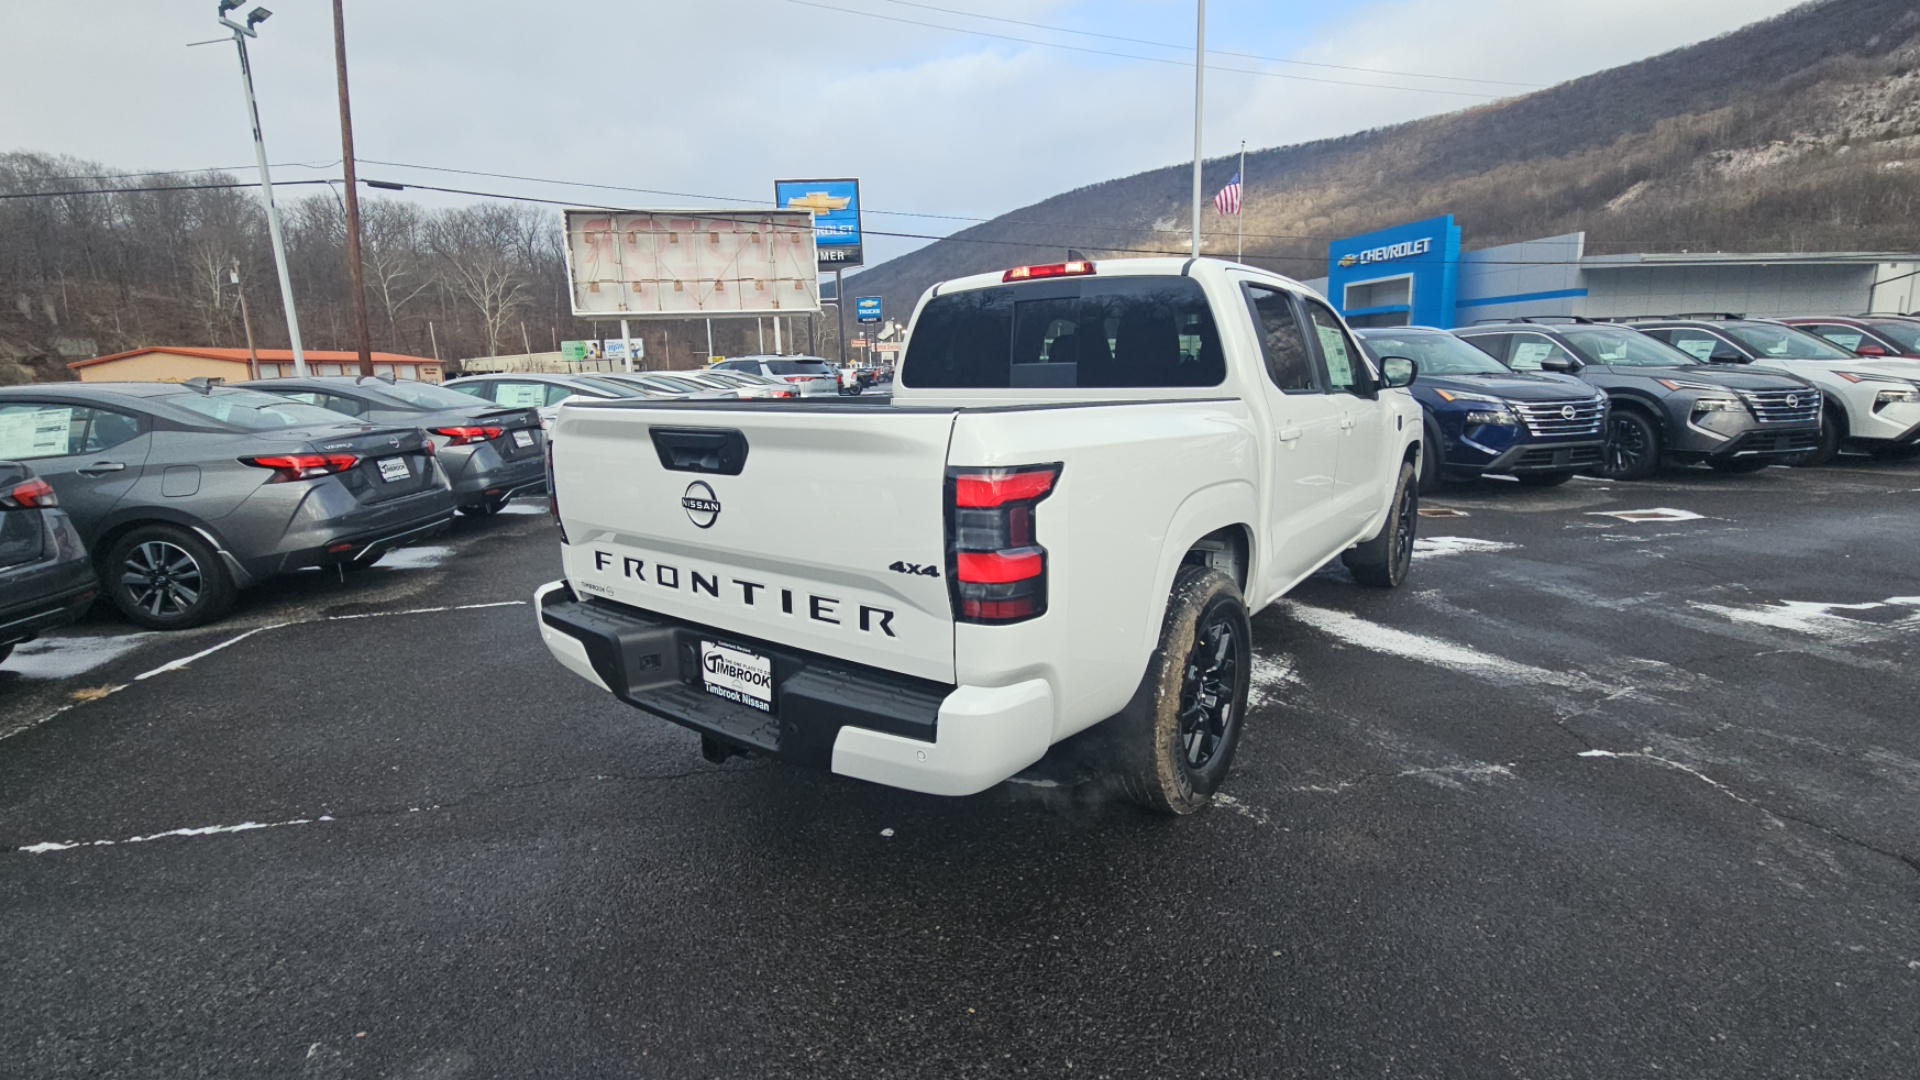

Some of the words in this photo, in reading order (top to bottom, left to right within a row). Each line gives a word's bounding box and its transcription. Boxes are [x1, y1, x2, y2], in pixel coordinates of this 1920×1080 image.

[816, 225, 854, 236] ROLET
[1360, 237, 1433, 264] CHEVROLET
[682, 499, 719, 511] NISSAN
[594, 550, 897, 638] FRONTIER
[704, 651, 770, 688] TIMBROOK
[704, 681, 741, 702] Timbrook
[741, 693, 770, 712] Nissan
